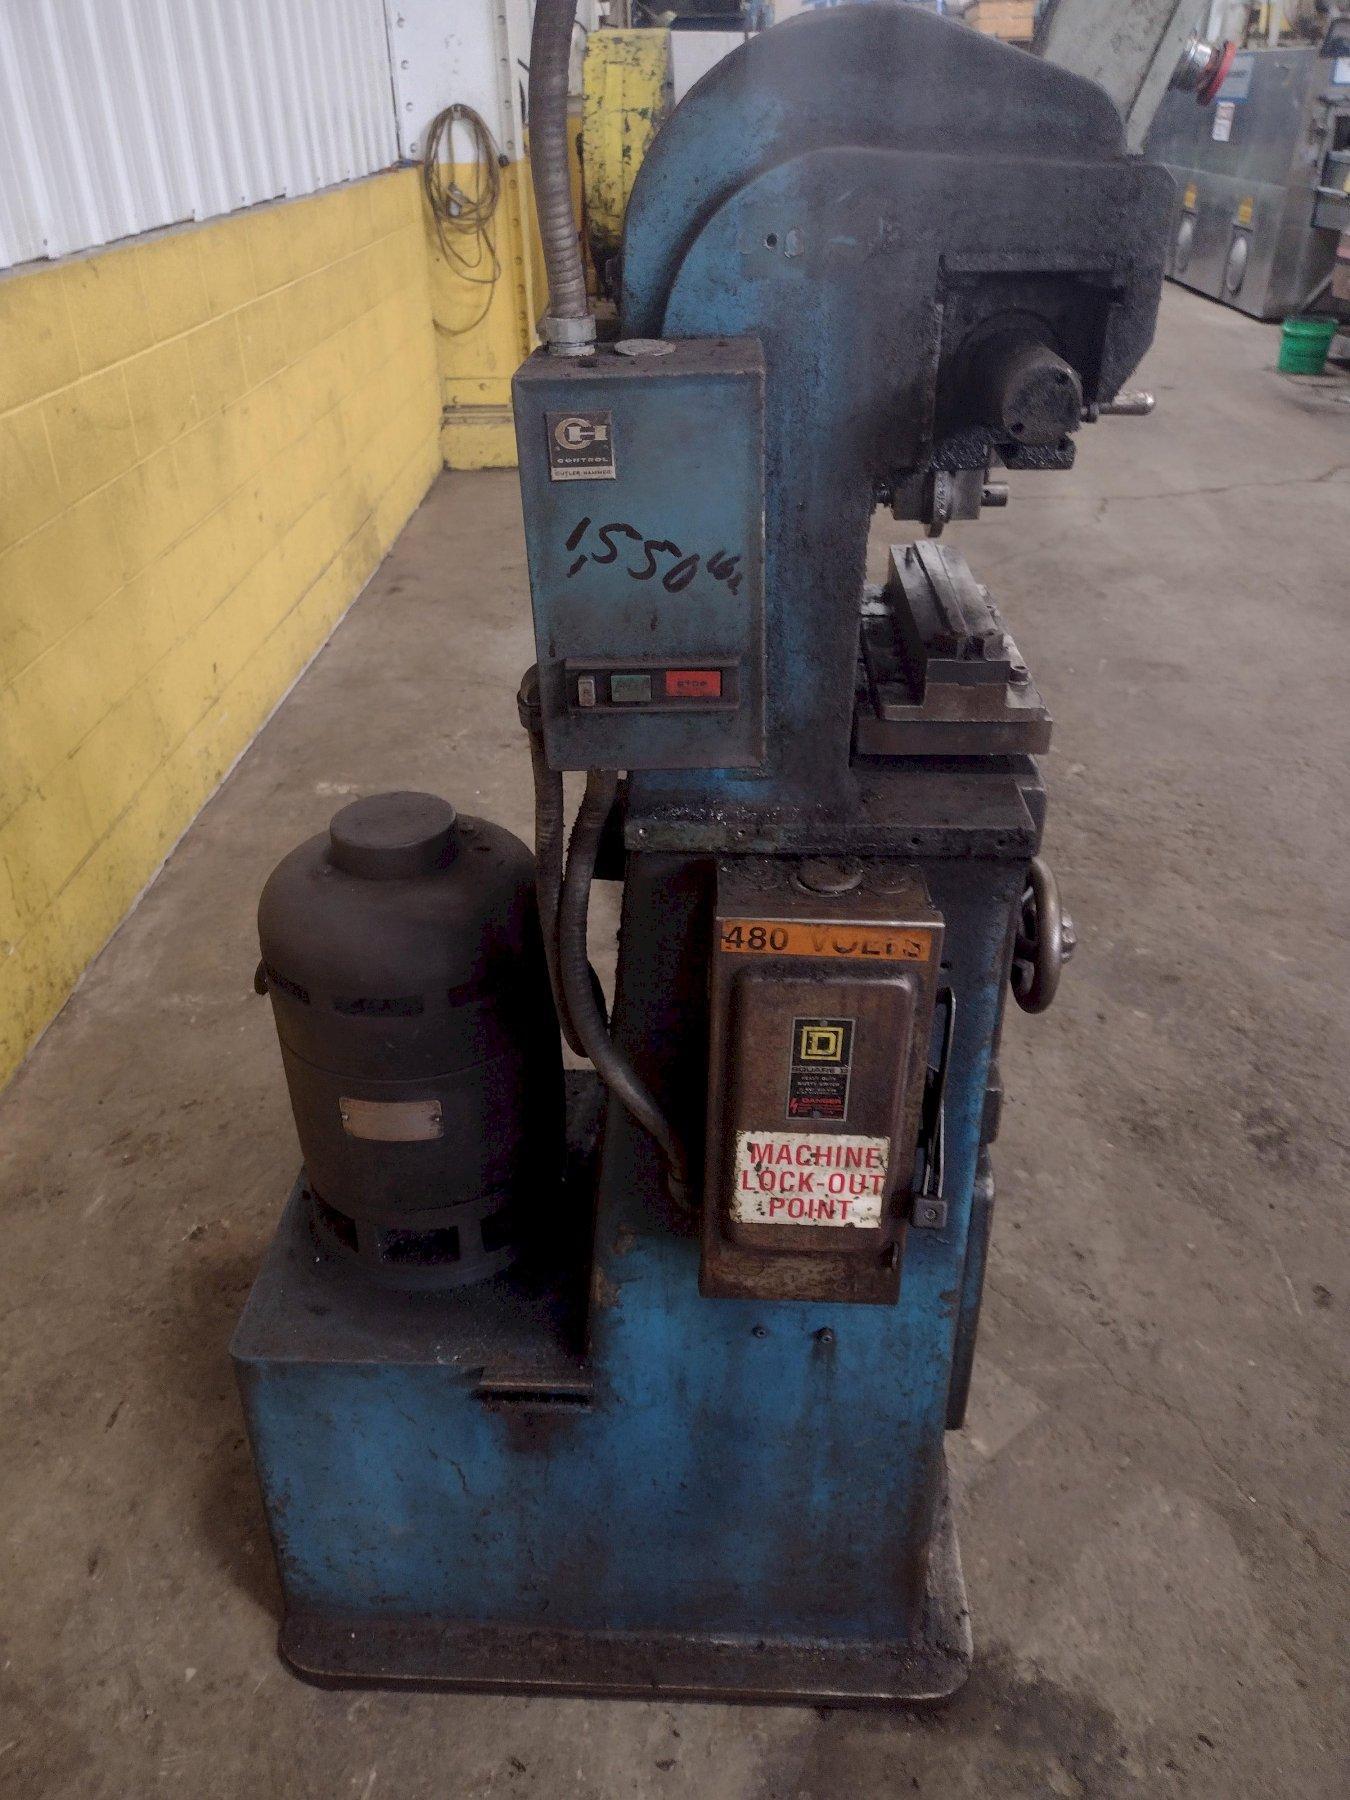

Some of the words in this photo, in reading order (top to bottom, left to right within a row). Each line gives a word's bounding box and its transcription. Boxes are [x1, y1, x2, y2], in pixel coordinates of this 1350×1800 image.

[556, 456, 609, 464] CONTROL
[721, 926, 789, 951] 480
[749, 1142, 882, 1169] MACHINE
[742, 1169, 887, 1196] LOCK-OUT
[768, 1197, 853, 1220] POINT
